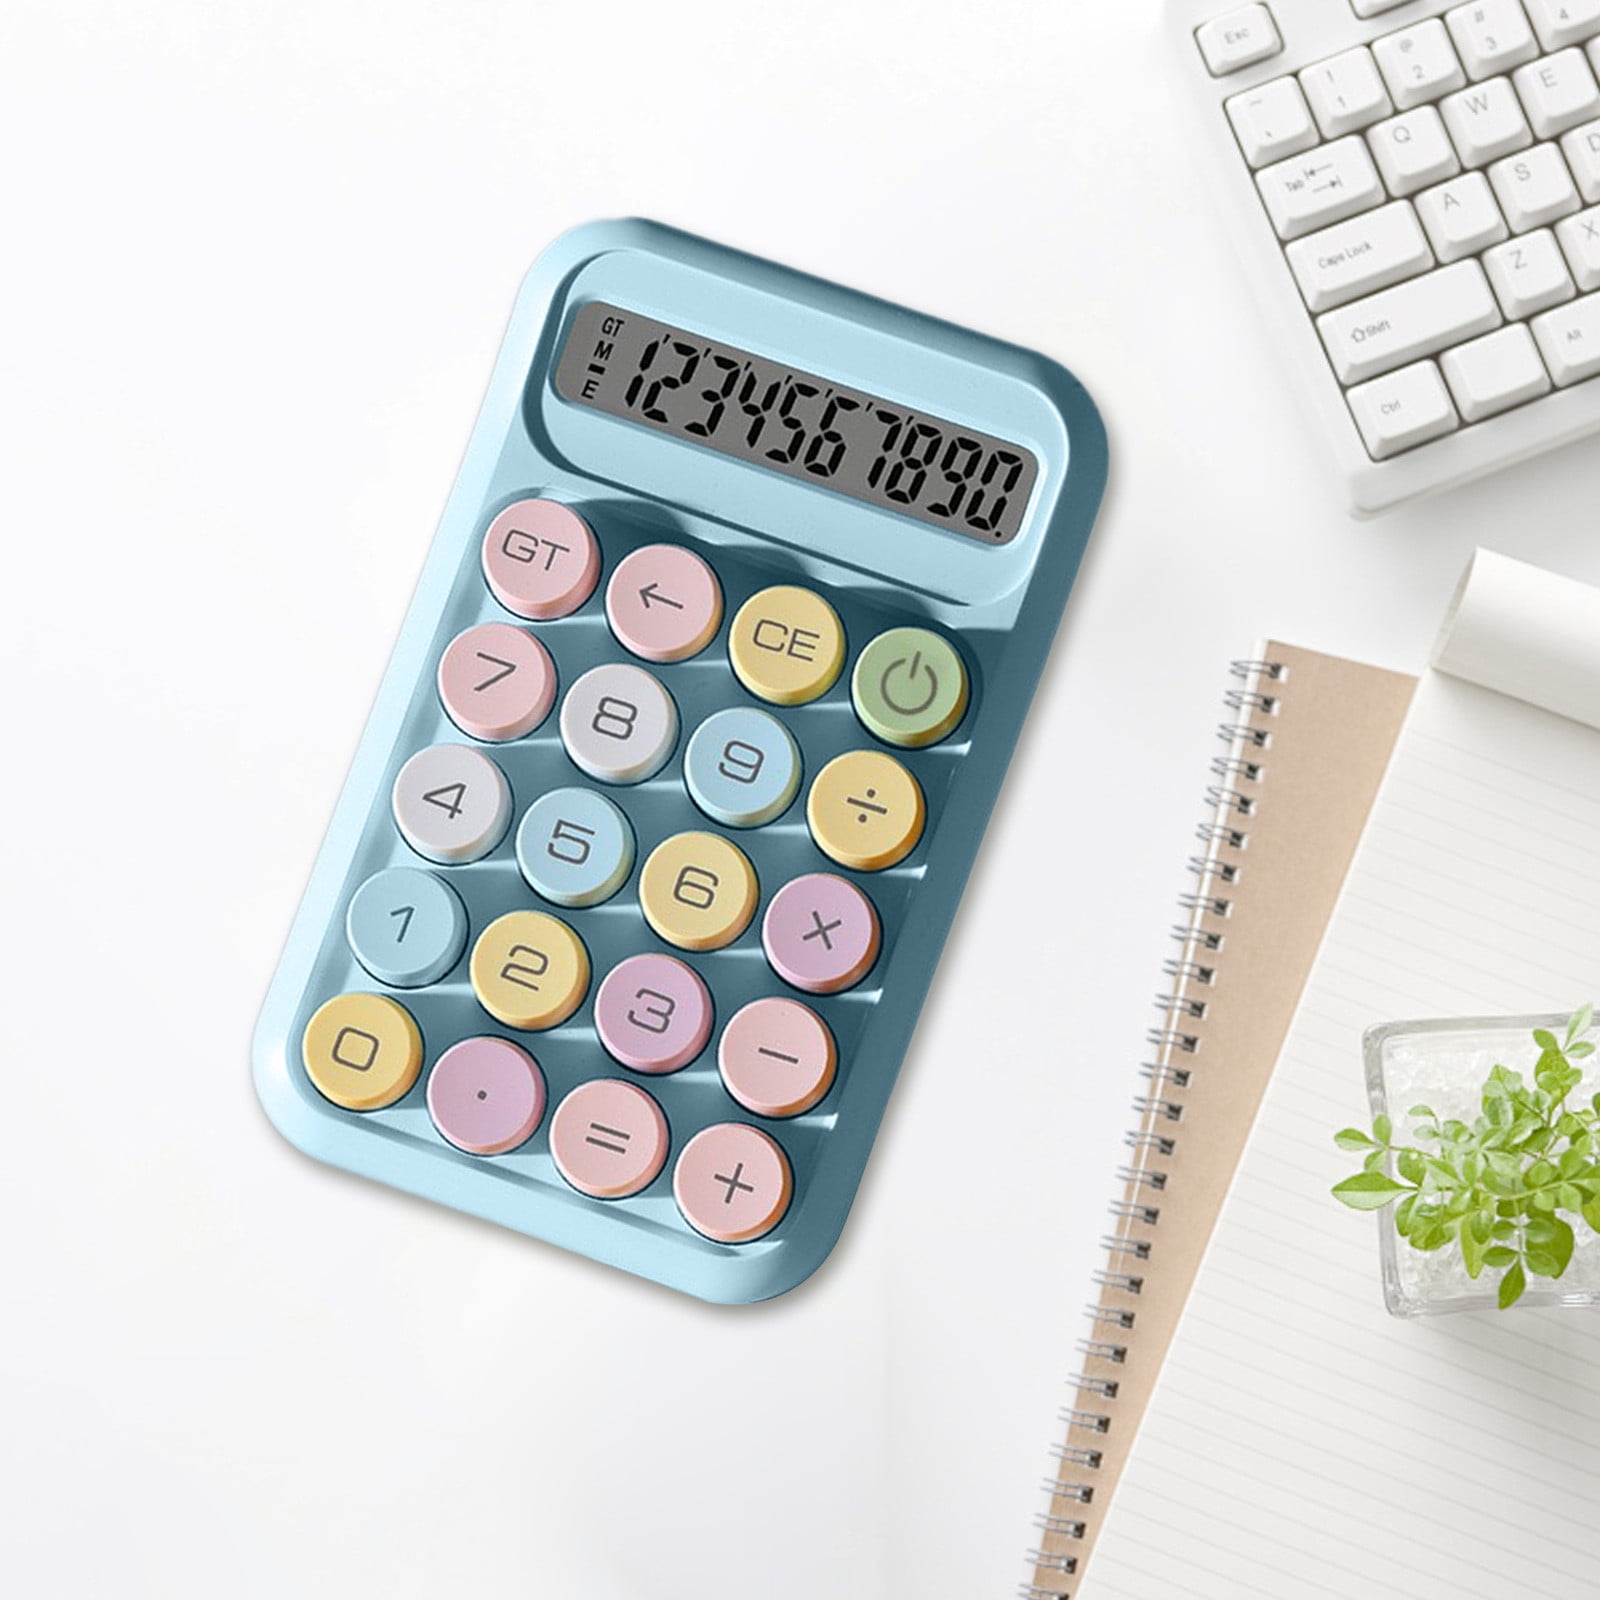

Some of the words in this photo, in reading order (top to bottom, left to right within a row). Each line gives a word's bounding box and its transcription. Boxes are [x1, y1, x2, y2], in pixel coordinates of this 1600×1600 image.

[1412, 64, 1426, 80] 2
[1538, 67, 1558, 89] E
[1464, 92, 1490, 116] W
[1392, 125, 1412, 145] Q
[1513, 162, 1532, 182] S
[1442, 191, 1461, 211] A
[1581, 219, 1600, 241] X
[1317, 253, 1346, 269] Caps
[1344, 241, 1373, 260] Lock
[1508, 248, 1528, 270] Z
[601, 316, 625, 338] GT
[593, 339, 614, 361] M
[580, 378, 600, 400] E
[502, 529, 570, 572] GT
[752, 618, 821, 663] CE
[474, 651, 517, 692] 7
[591, 696, 638, 741] 8
[718, 740, 765, 784] 9
[422, 782, 467, 820] 4
[547, 819, 596, 865] 5
[672, 865, 719, 910] 6
[390, 905, 415, 944] 1
[500, 944, 549, 992] 2
[627, 987, 676, 1034] 3
